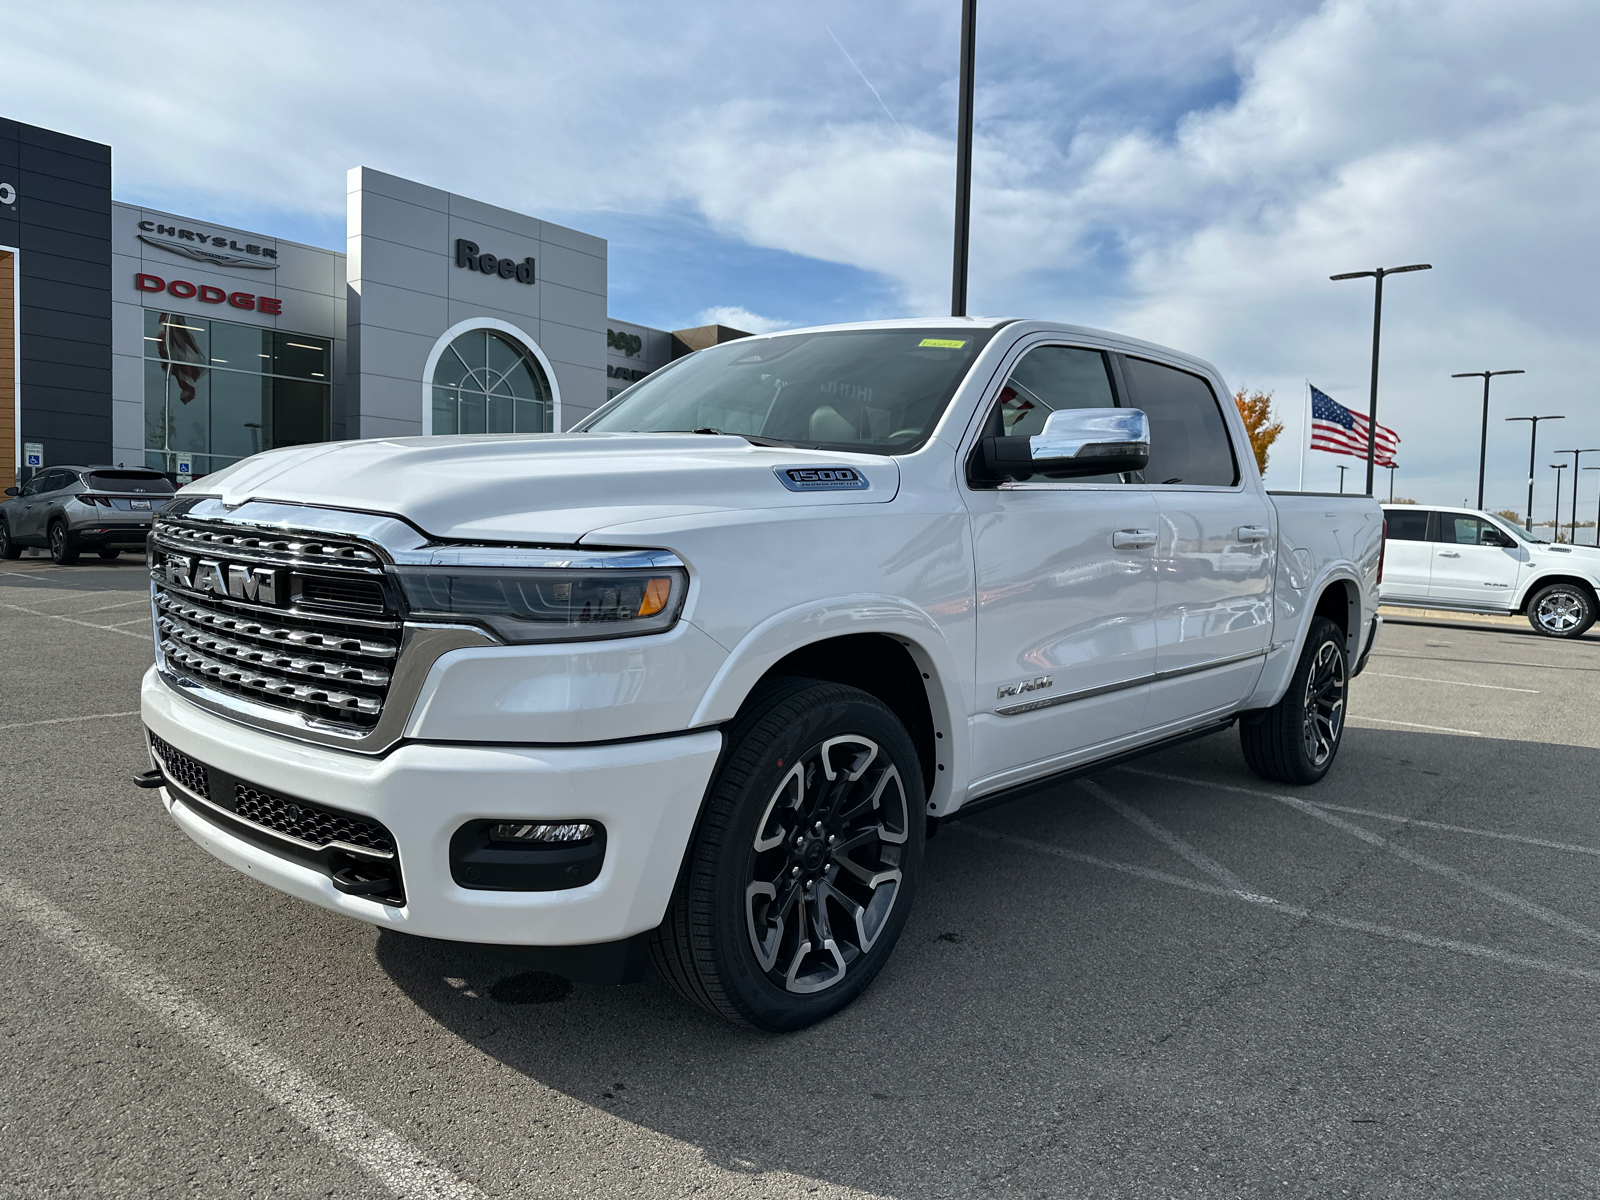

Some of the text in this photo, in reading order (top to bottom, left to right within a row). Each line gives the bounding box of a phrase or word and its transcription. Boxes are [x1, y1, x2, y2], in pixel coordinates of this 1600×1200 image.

[139, 220, 278, 259] CHRYSLER
[456, 238, 535, 285] Reed
[136, 272, 282, 315] DODGE
[607, 328, 642, 357] eep
[788, 470, 854, 481] 1500
[165, 553, 276, 604] RAM
[997, 675, 1053, 699] RAM
